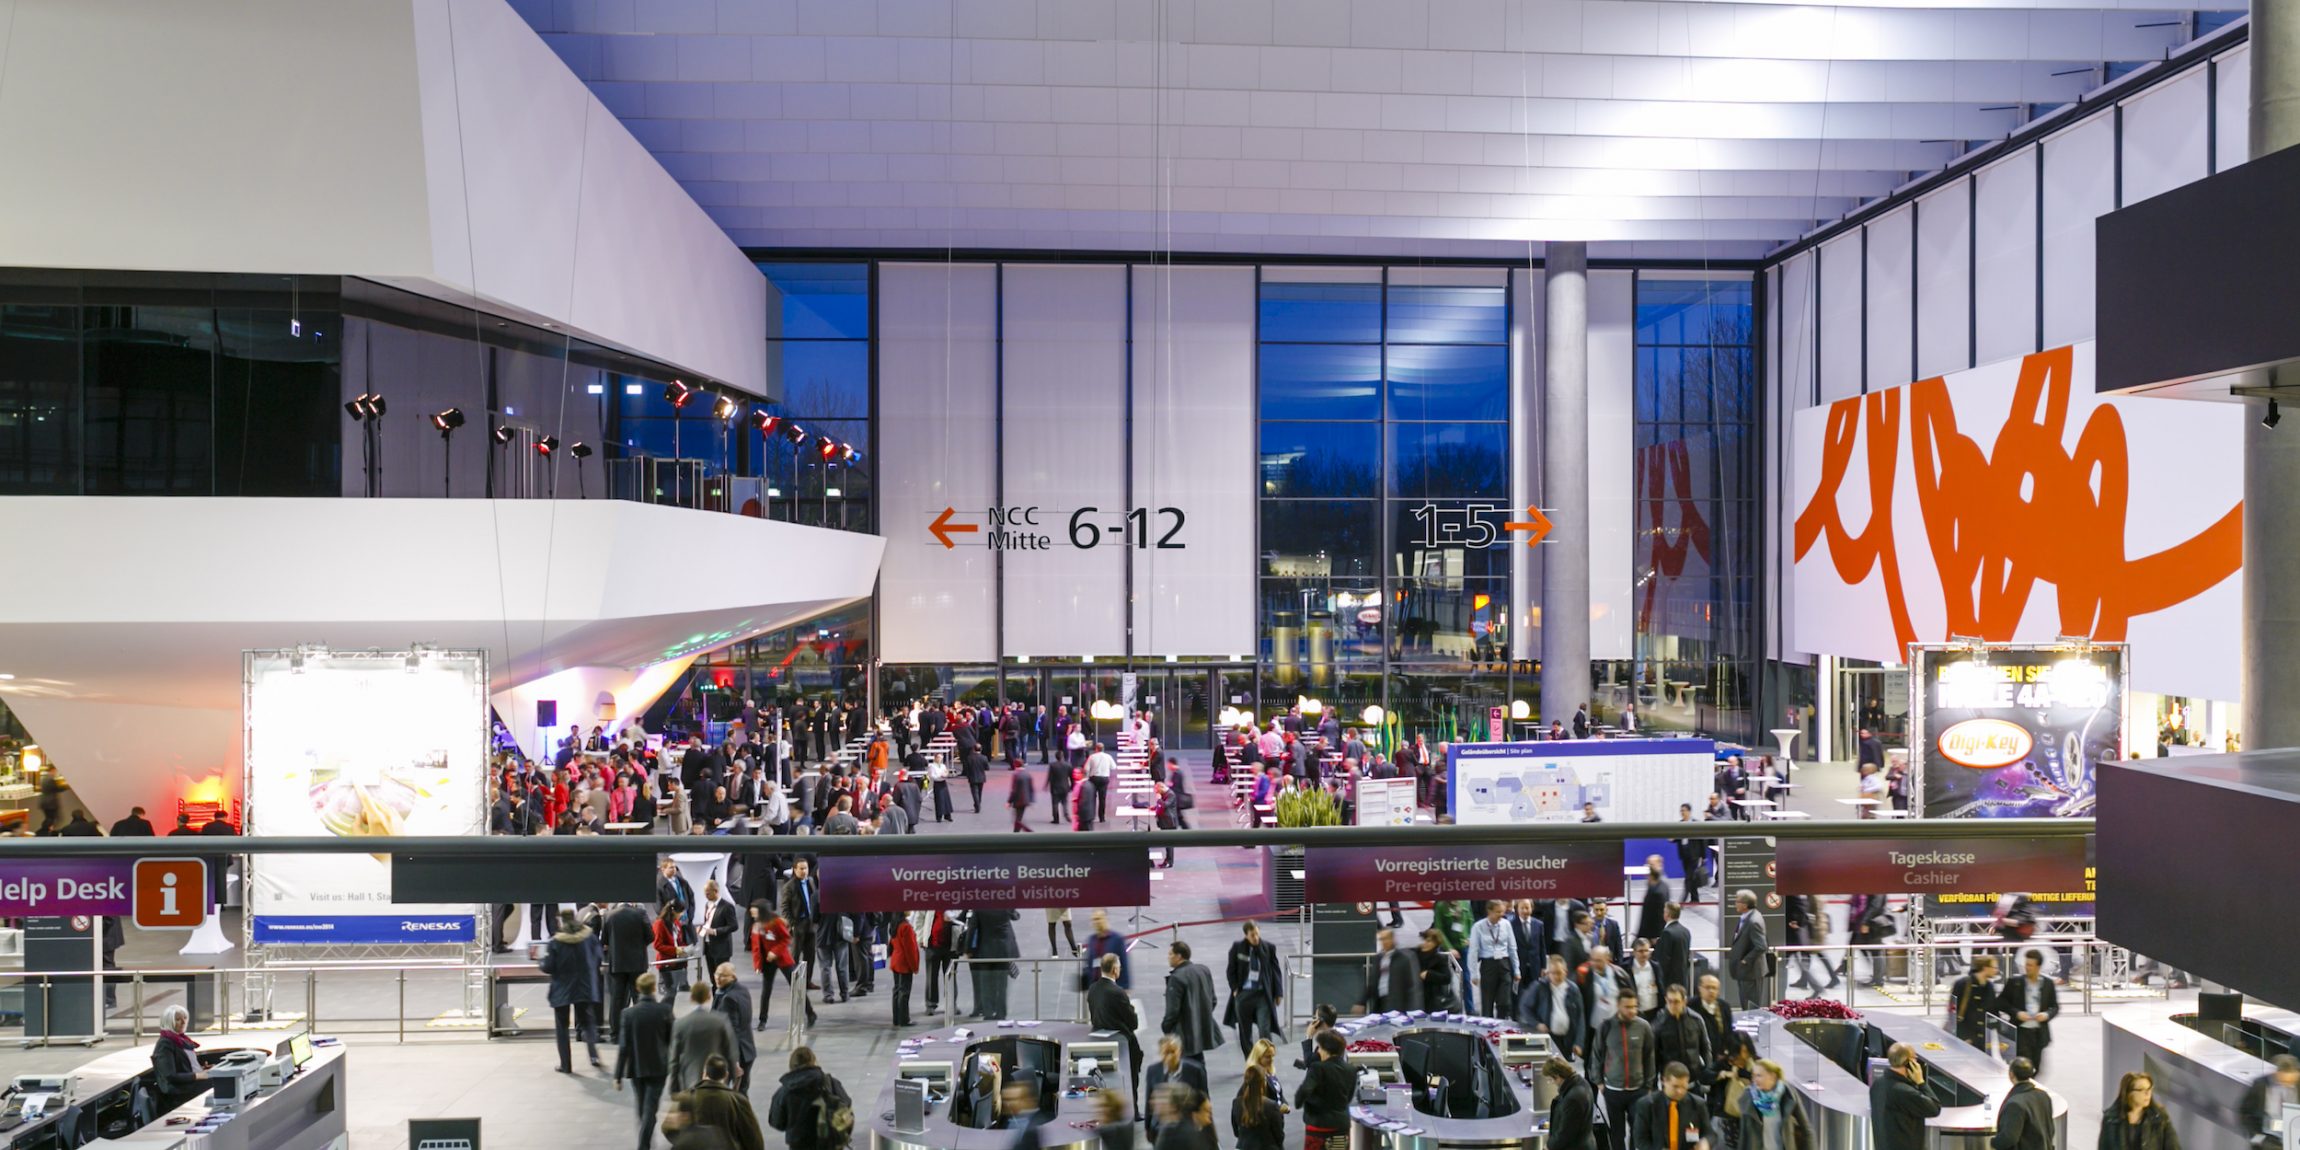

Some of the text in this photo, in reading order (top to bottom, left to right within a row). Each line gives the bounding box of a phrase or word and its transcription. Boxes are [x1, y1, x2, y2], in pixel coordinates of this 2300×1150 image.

[989, 506, 1039, 526] NCC
[1415, 503, 1497, 548] 1-5
[988, 530, 1051, 550] Mitte
[1374, 856, 1568, 875] Vorregistrierte Besucher
[1889, 851, 1976, 869] Tageskasse
[892, 864, 1091, 884] Vorregistrierte Besucher
[1903, 870, 1960, 885] Cashier
[57, 876, 126, 900] Desk
[902, 885, 1080, 905] Pre-registered visitors
[1385, 877, 1557, 895] Pre-registered visitors
[310, 892, 330, 901] Visit
[347, 892, 365, 901] Hall
[1938, 892, 1985, 903] VERFÜGBAR
[401, 921, 461, 932] RENESAS
